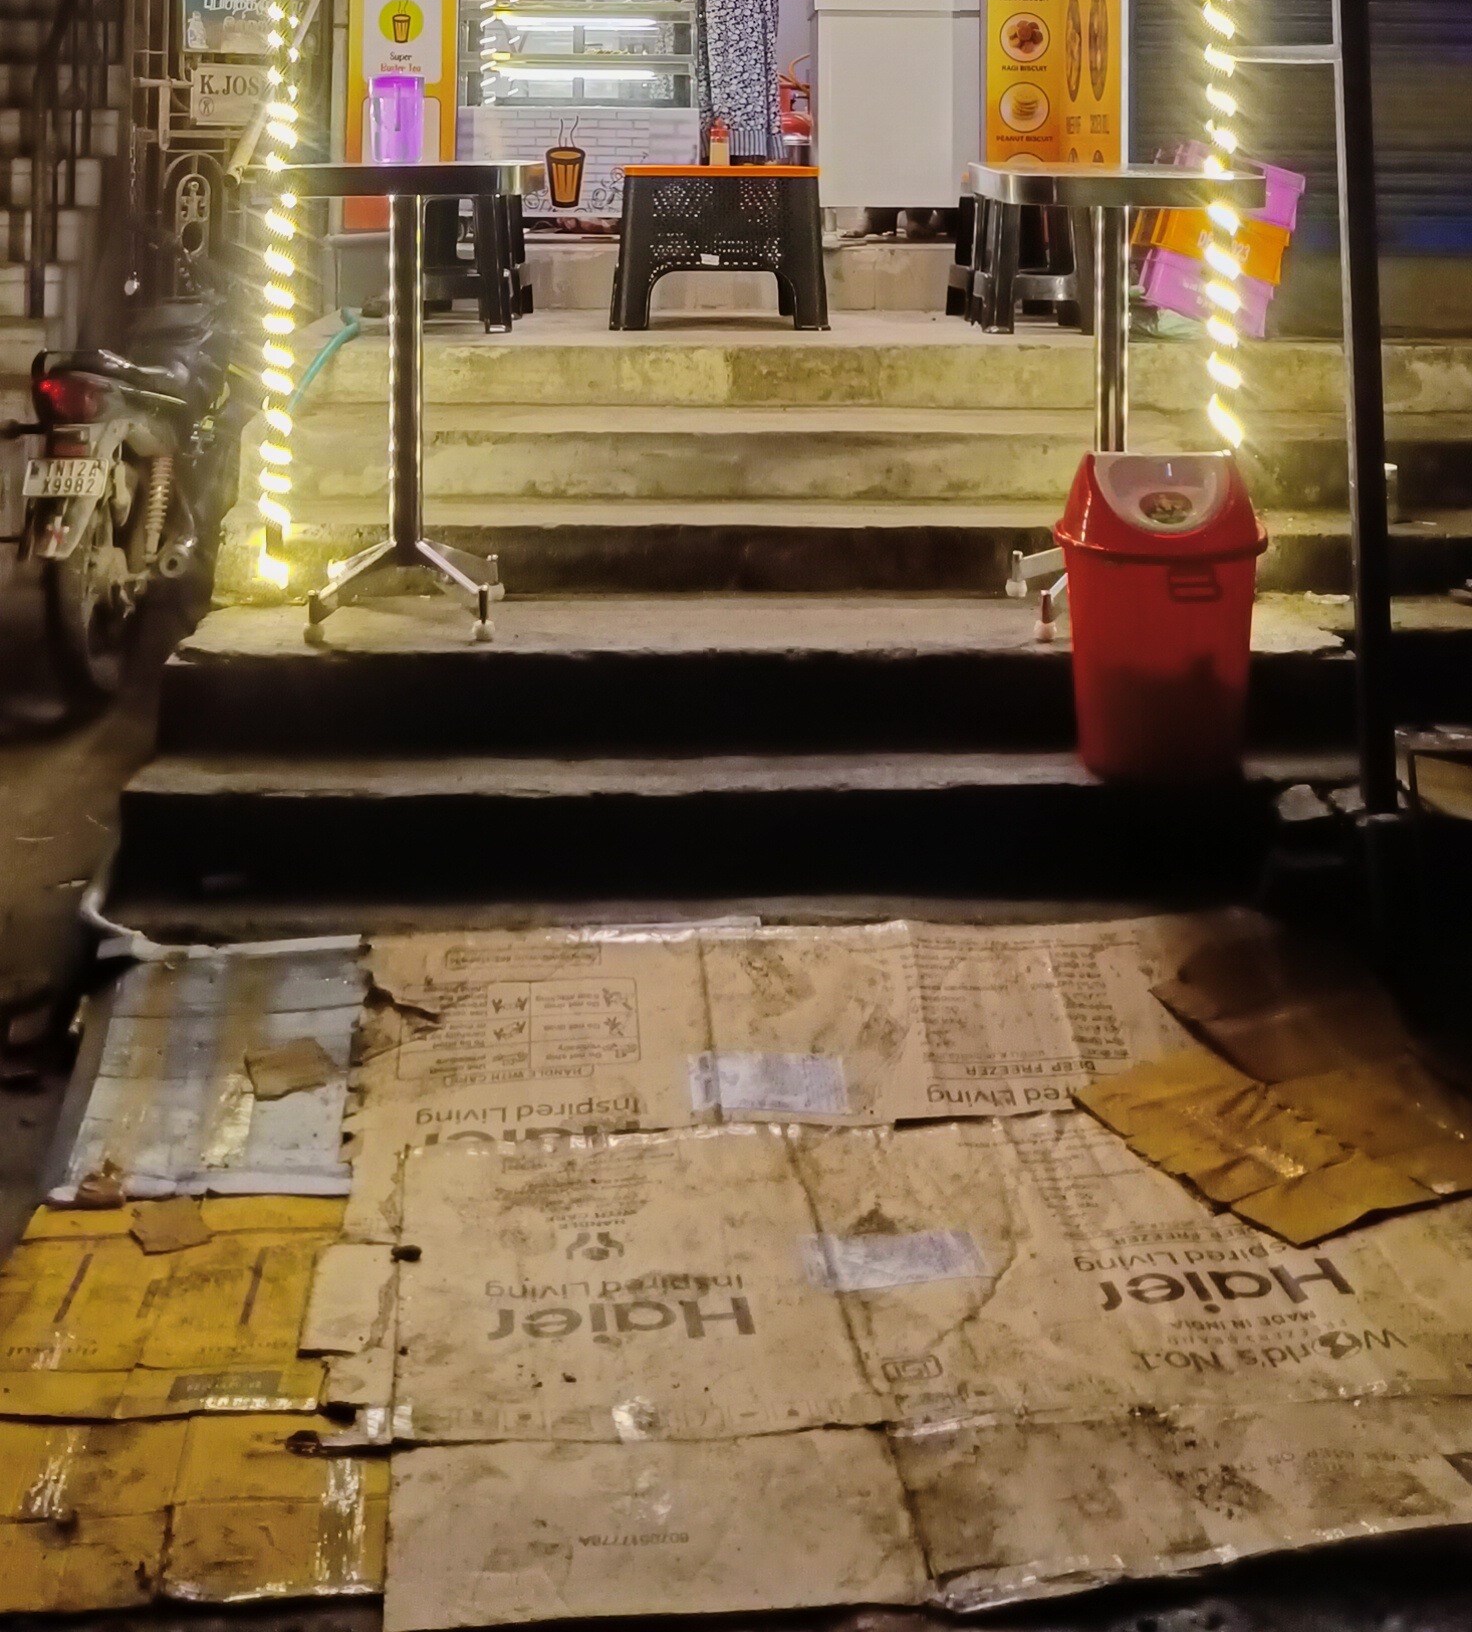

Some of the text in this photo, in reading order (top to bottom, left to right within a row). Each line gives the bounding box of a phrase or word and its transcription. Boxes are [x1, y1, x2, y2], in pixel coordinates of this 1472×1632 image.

[390, 52, 412, 63] Super
[408, 62, 421, 72] Tea
[996, 135, 1053, 143] PEANUT BISCUIT
[491, 1070, 524, 1083] WITH
[530, 1067, 581, 1080] HANDLE
[965, 1062, 1043, 1077] FREEZER
[415, 1095, 641, 1127] Inspired Living
[1073, 1250, 1178, 1273] Living
[484, 1272, 743, 1301] Inspired Living
[1099, 1257, 1356, 1315] Haier
[487, 1296, 757, 1348] Haier
[1169, 1309, 1317, 1332] MADE IN INDIA
